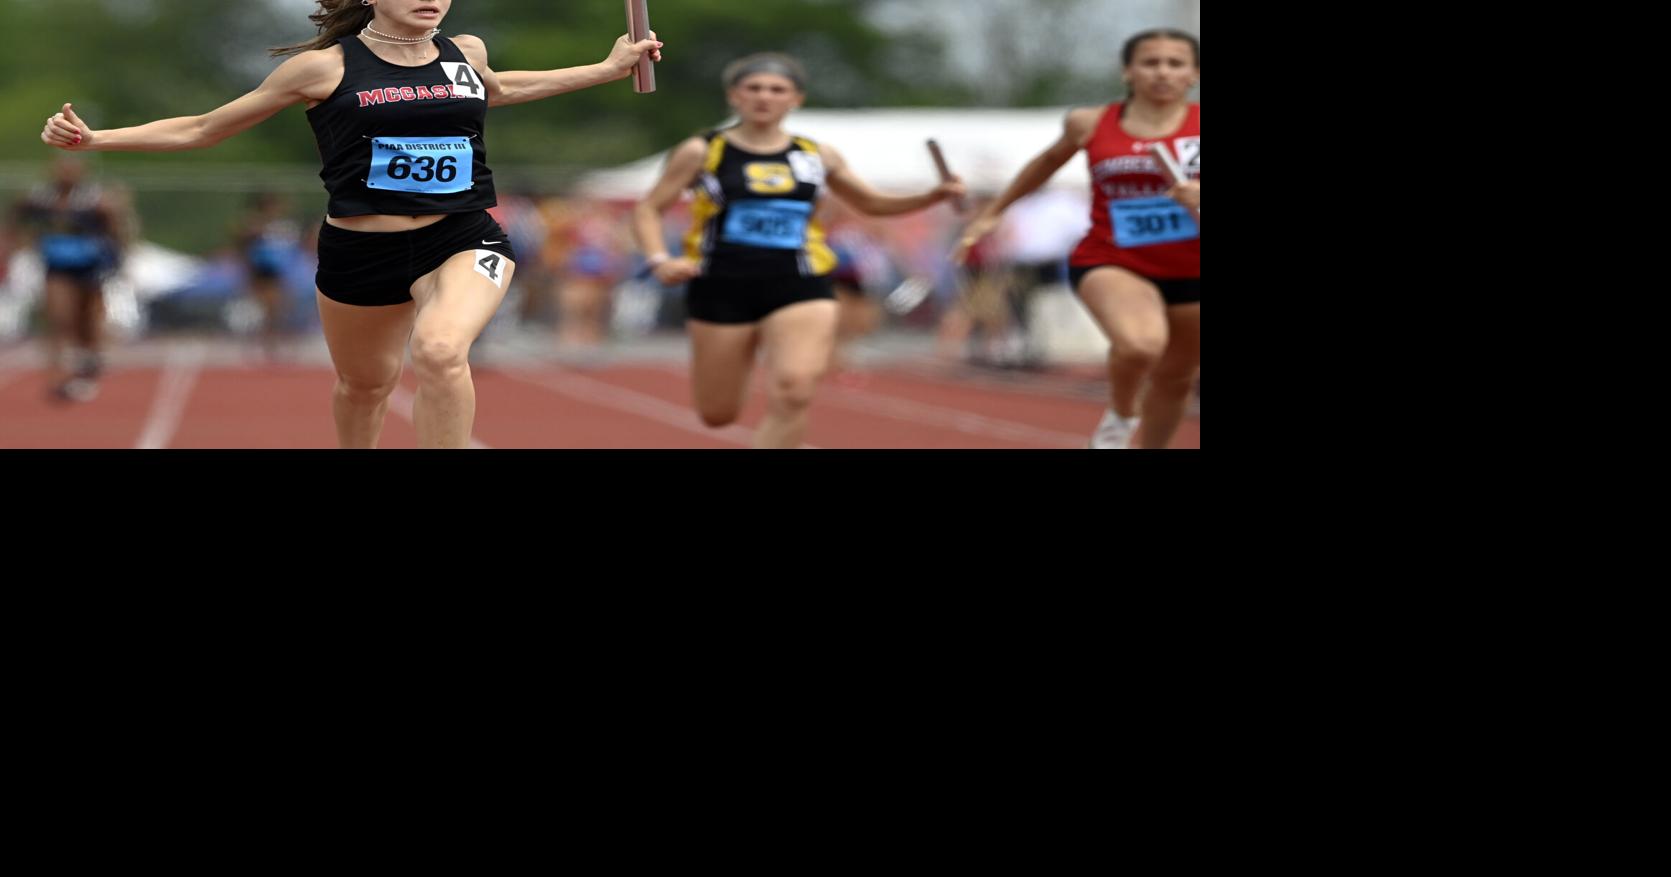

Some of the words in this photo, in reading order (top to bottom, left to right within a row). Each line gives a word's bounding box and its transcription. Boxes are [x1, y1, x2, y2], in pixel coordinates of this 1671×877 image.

[454, 64, 480, 95] 4
[378, 143, 403, 151] PIAA
[405, 143, 452, 151] DISTRICT
[1183, 140, 1200, 167] 2
[386, 155, 457, 183] 636
[1125, 212, 1180, 236] 301
[478, 253, 501, 281] 4
